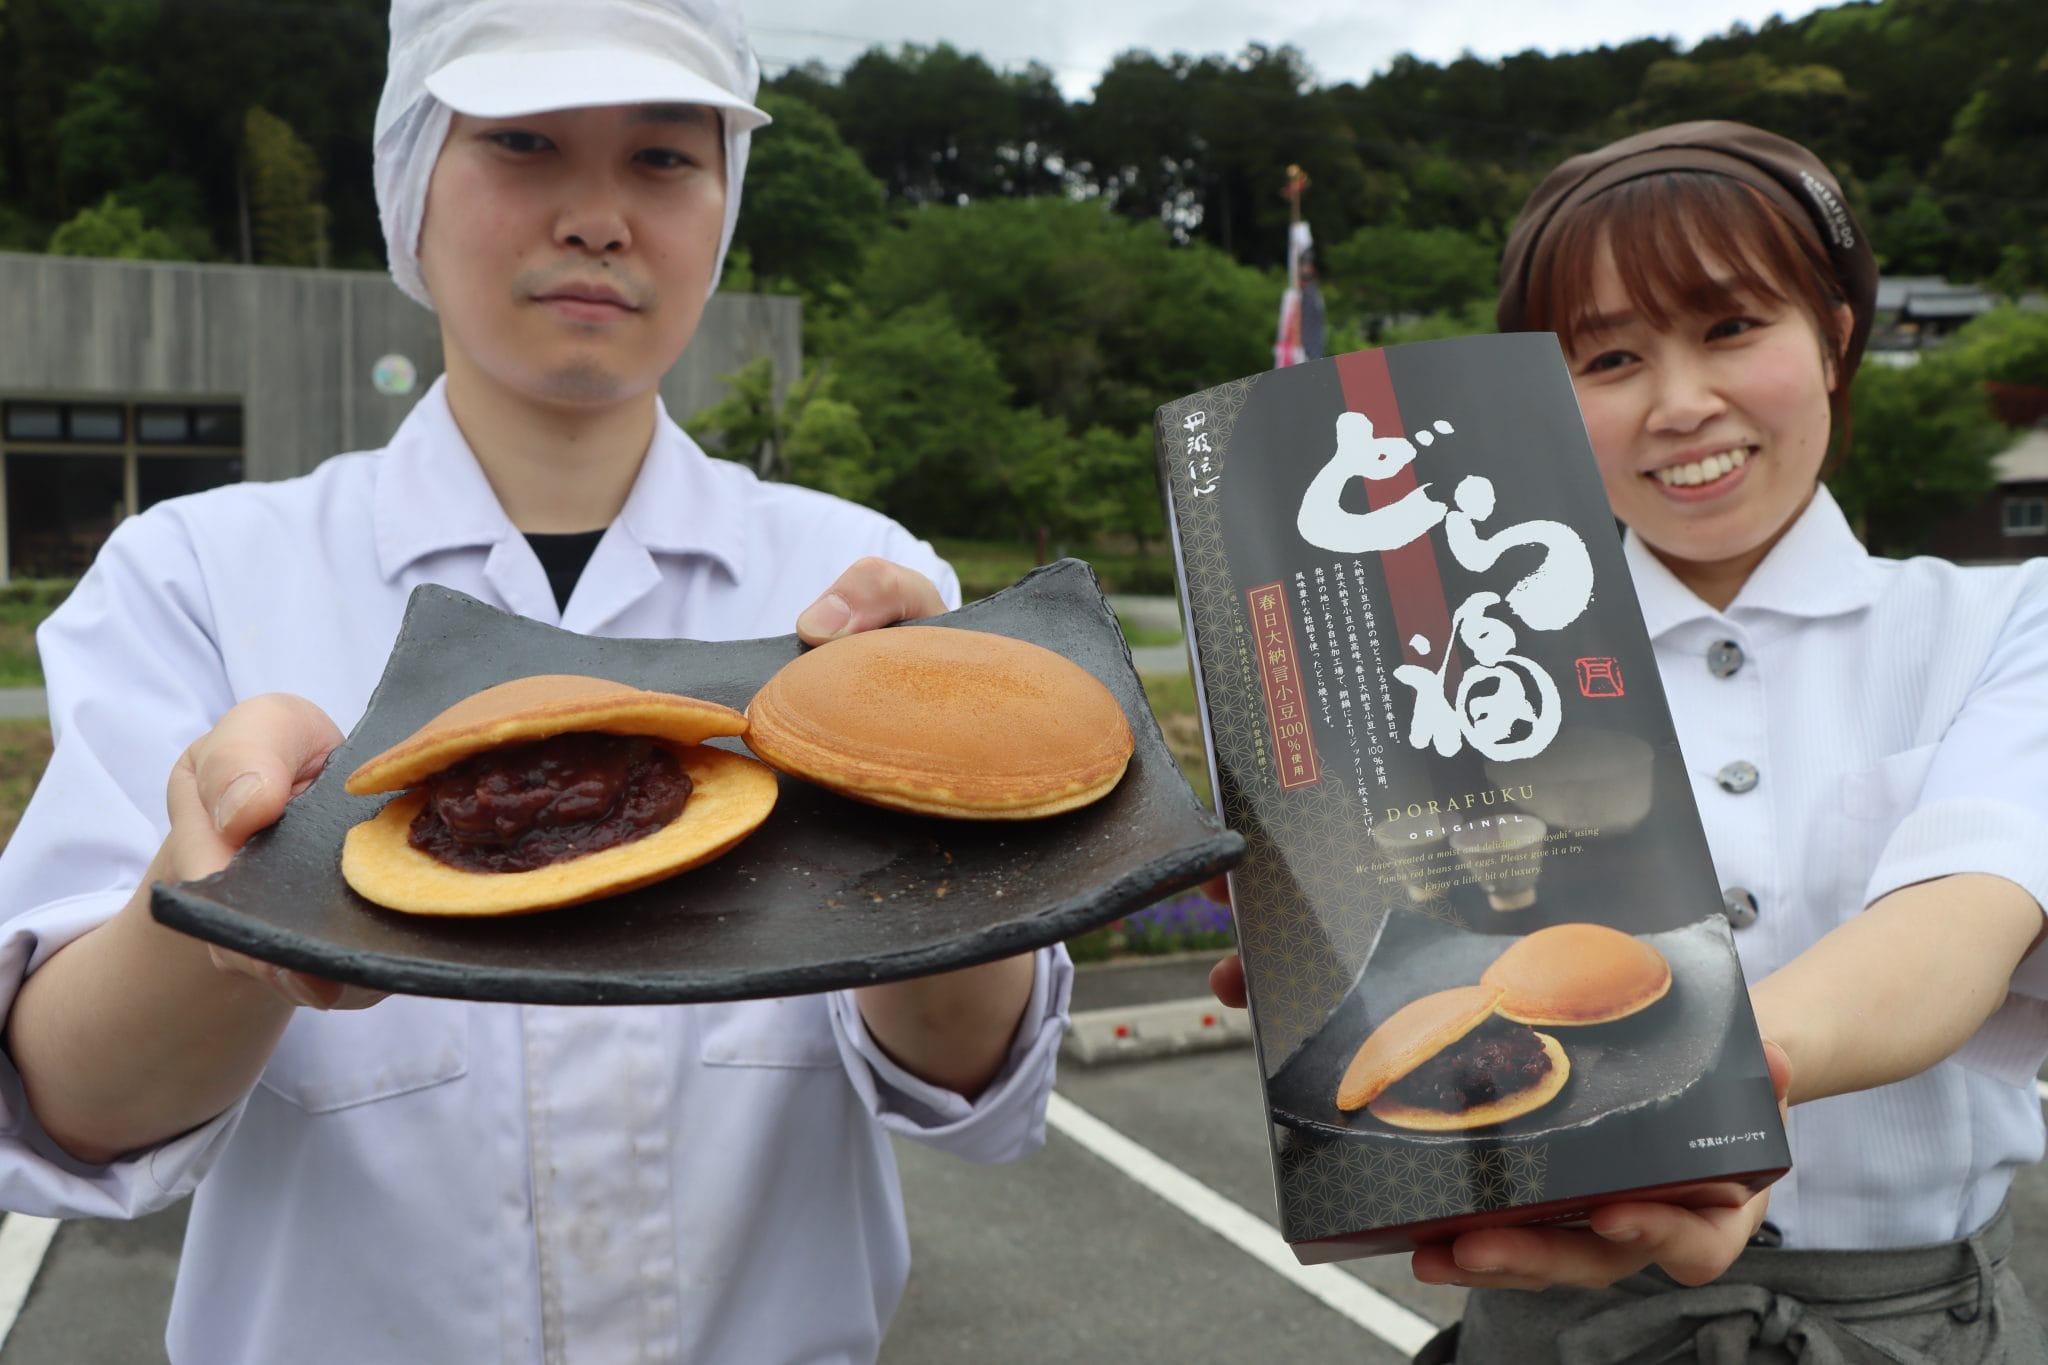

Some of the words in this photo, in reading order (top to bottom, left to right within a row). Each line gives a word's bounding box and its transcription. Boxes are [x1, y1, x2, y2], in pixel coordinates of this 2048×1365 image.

[1183, 411, 1220, 497] 丹波伝心
[1297, 411, 1595, 762] どら福
[1258, 593, 1305, 777] 春日大納言小豆100%使用
[1386, 785, 1533, 822] DORAFUKU
[1409, 815, 1523, 840] ORIGINAL
[1437, 847, 1460, 859] moist
[1575, 827, 1600, 838] using
[1410, 868, 1424, 879] red
[1427, 865, 1452, 876] beans
[1454, 860, 1472, 871] and
[1500, 853, 1528, 864] Please
[1530, 849, 1549, 860] give
[1569, 845, 1584, 854] try.
[1425, 880, 1451, 893] Enjoy
[1462, 874, 1482, 885] little
[1485, 871, 1497, 881] bit
[1499, 870, 1508, 880] of
[1511, 866, 1543, 877] luxury.
[1688, 1130, 1767, 1149] ※写真はイメージです
